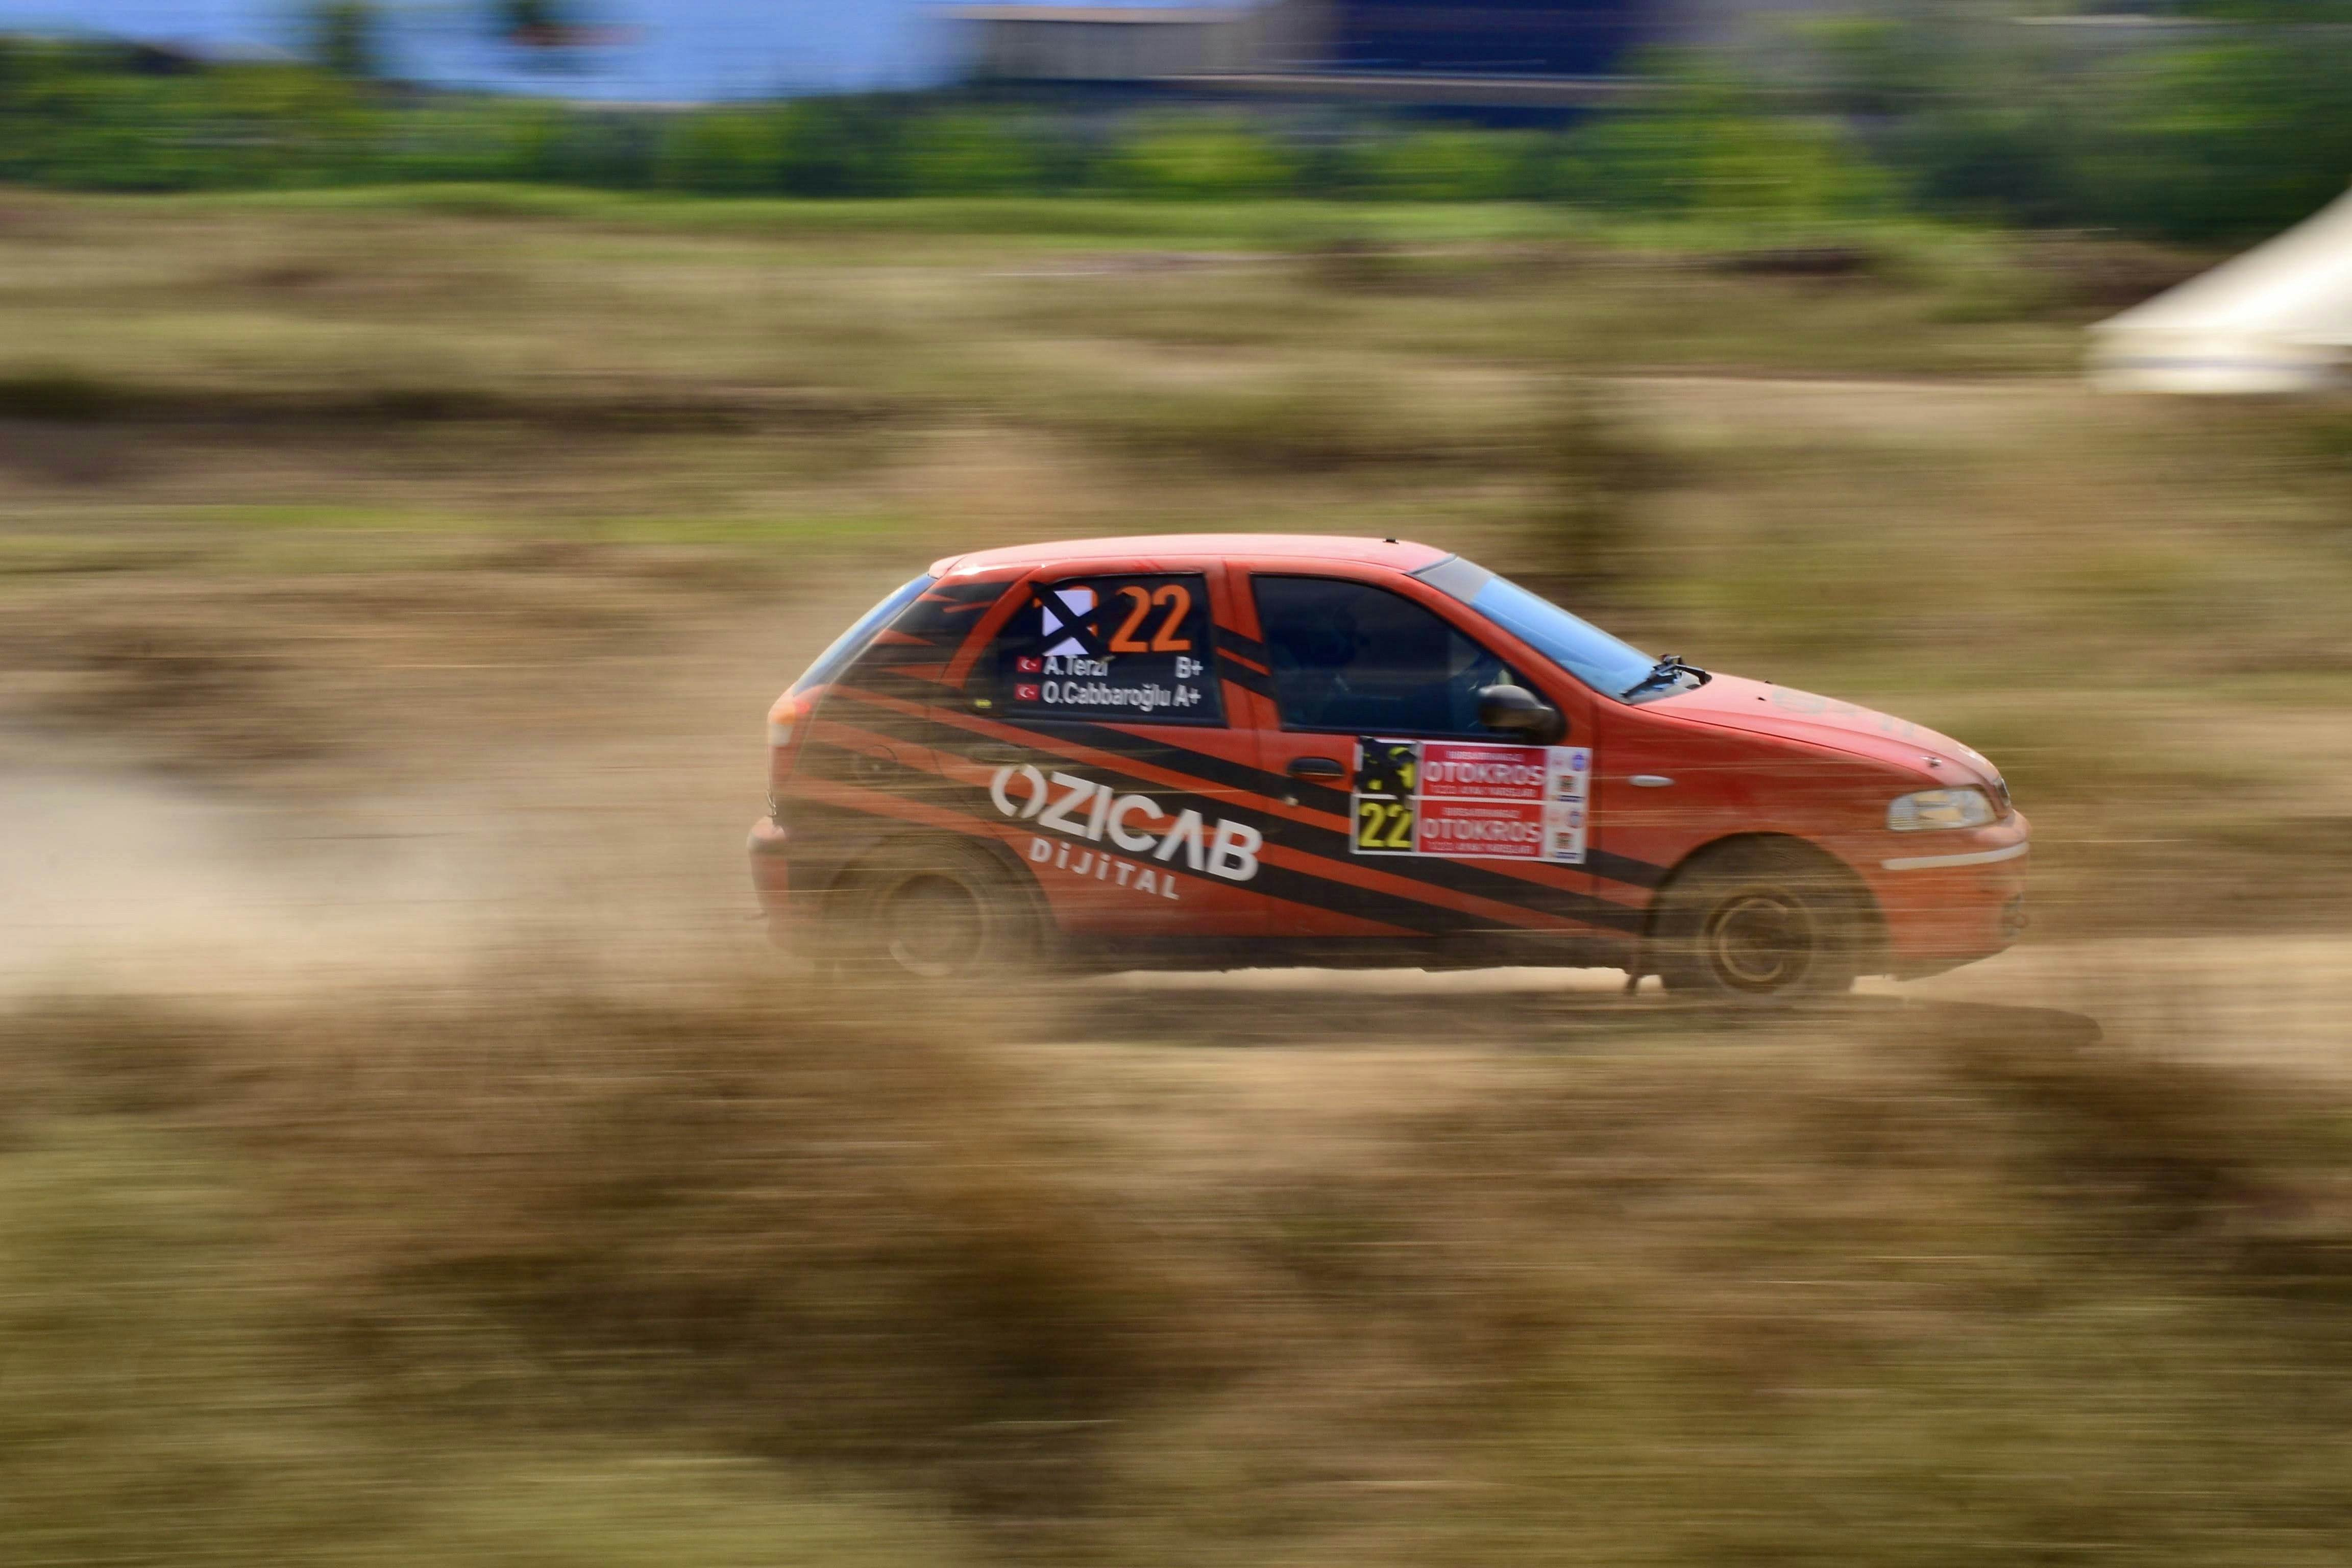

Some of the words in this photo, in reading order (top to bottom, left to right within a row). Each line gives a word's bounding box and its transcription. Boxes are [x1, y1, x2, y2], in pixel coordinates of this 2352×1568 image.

[1175, 656, 1203, 678] B+
[1042, 680, 1171, 712] O.Cabbaroğlu
[1172, 684, 1201, 706] A+
[1424, 762, 1545, 786] OTOKROS
[1359, 802, 1412, 848] 22
[1420, 818, 1541, 842] OTOKROS
